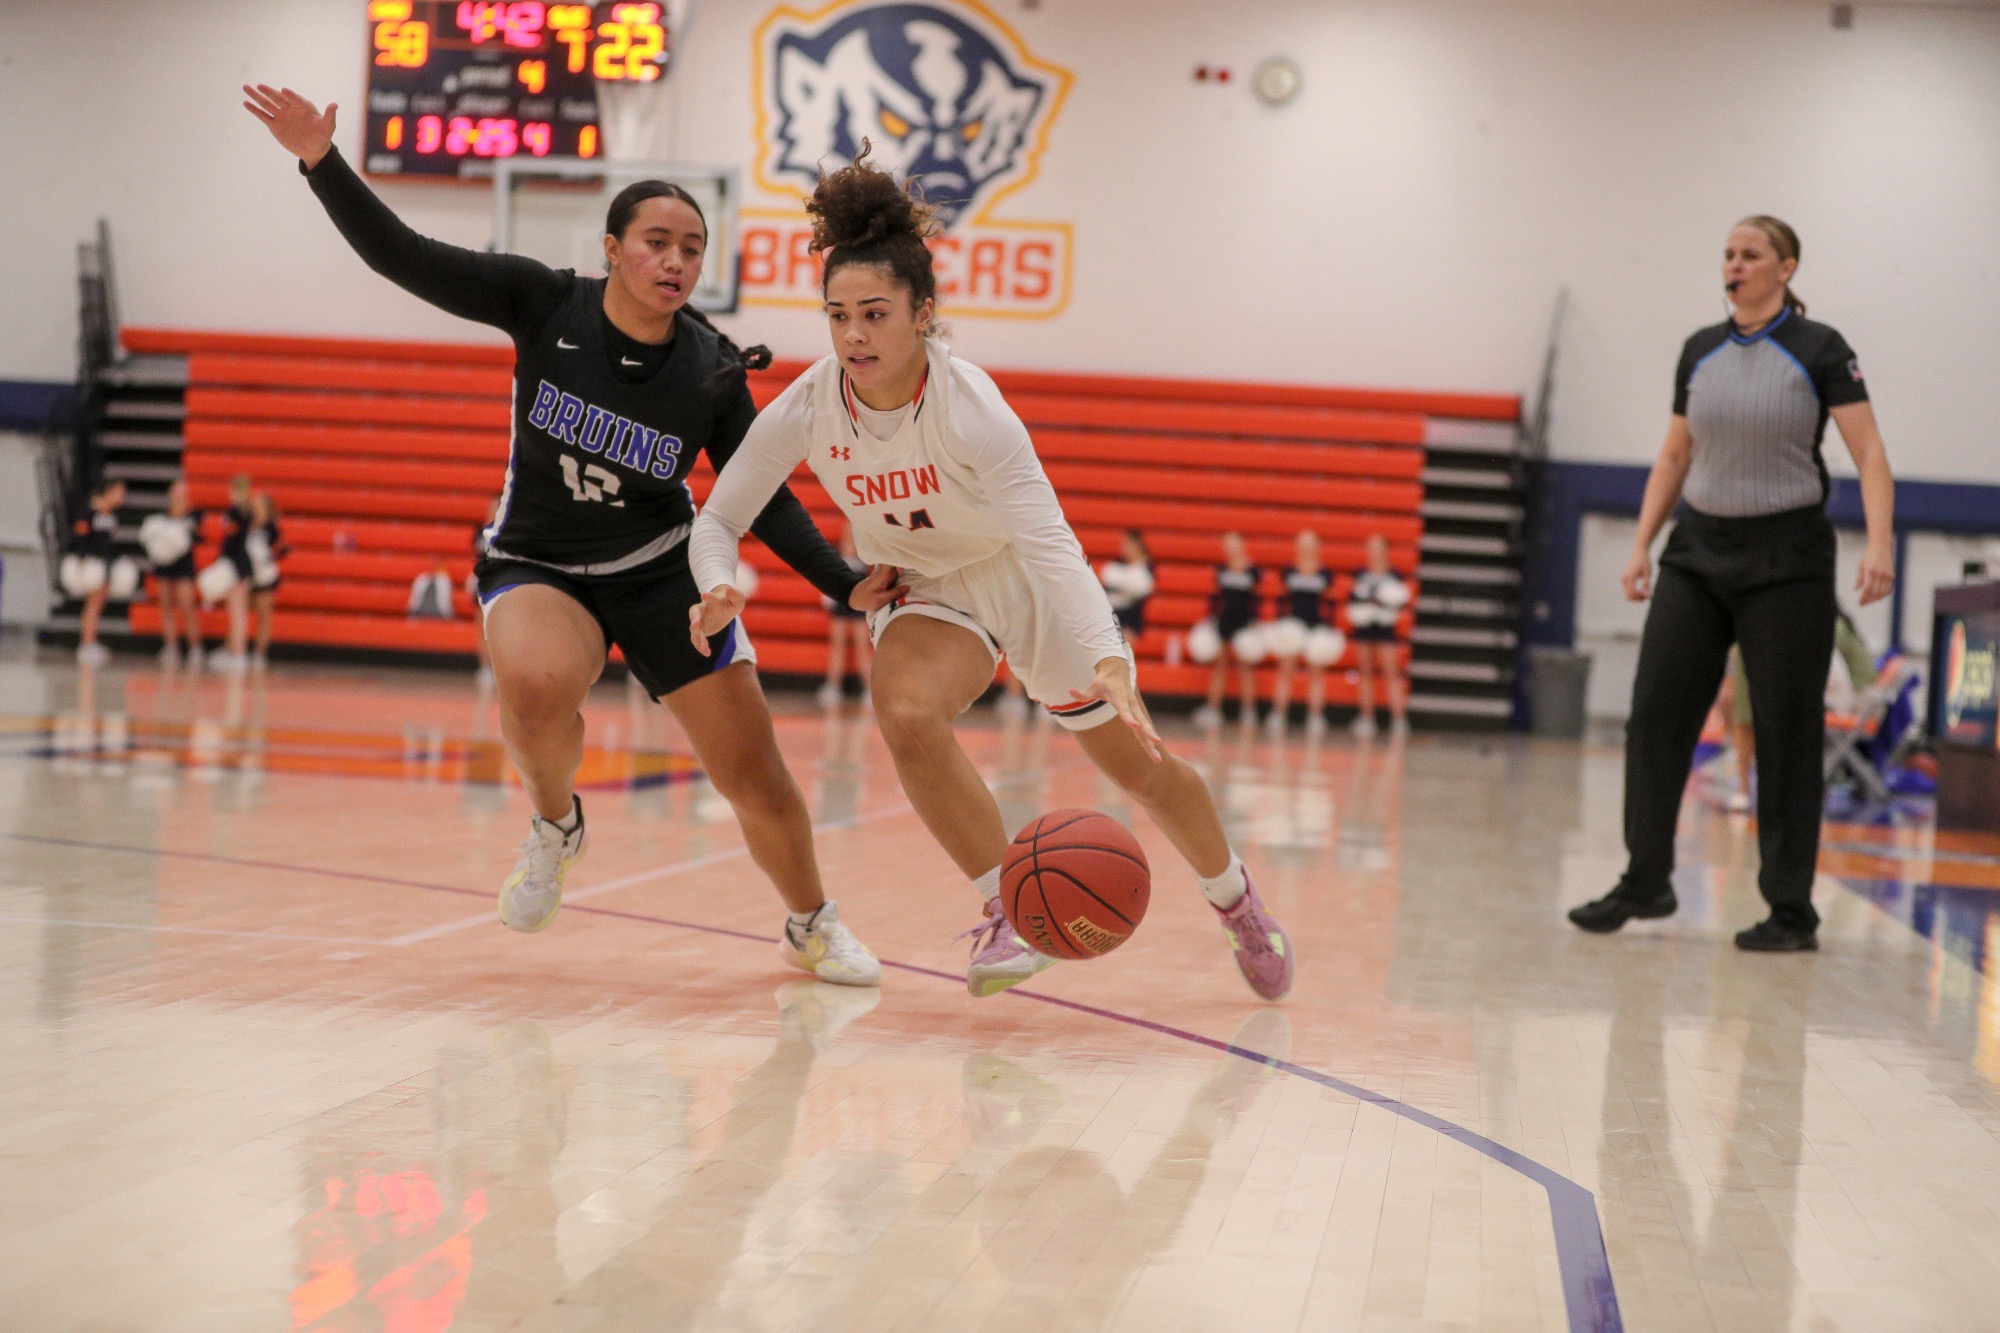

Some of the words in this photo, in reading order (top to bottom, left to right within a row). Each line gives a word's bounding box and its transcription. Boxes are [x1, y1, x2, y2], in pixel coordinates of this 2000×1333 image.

[593, 22, 665, 81] 22
[741, 228, 1056, 299] BAERS
[528, 379, 682, 479] BRUINS
[846, 464, 941, 506] SNOW
